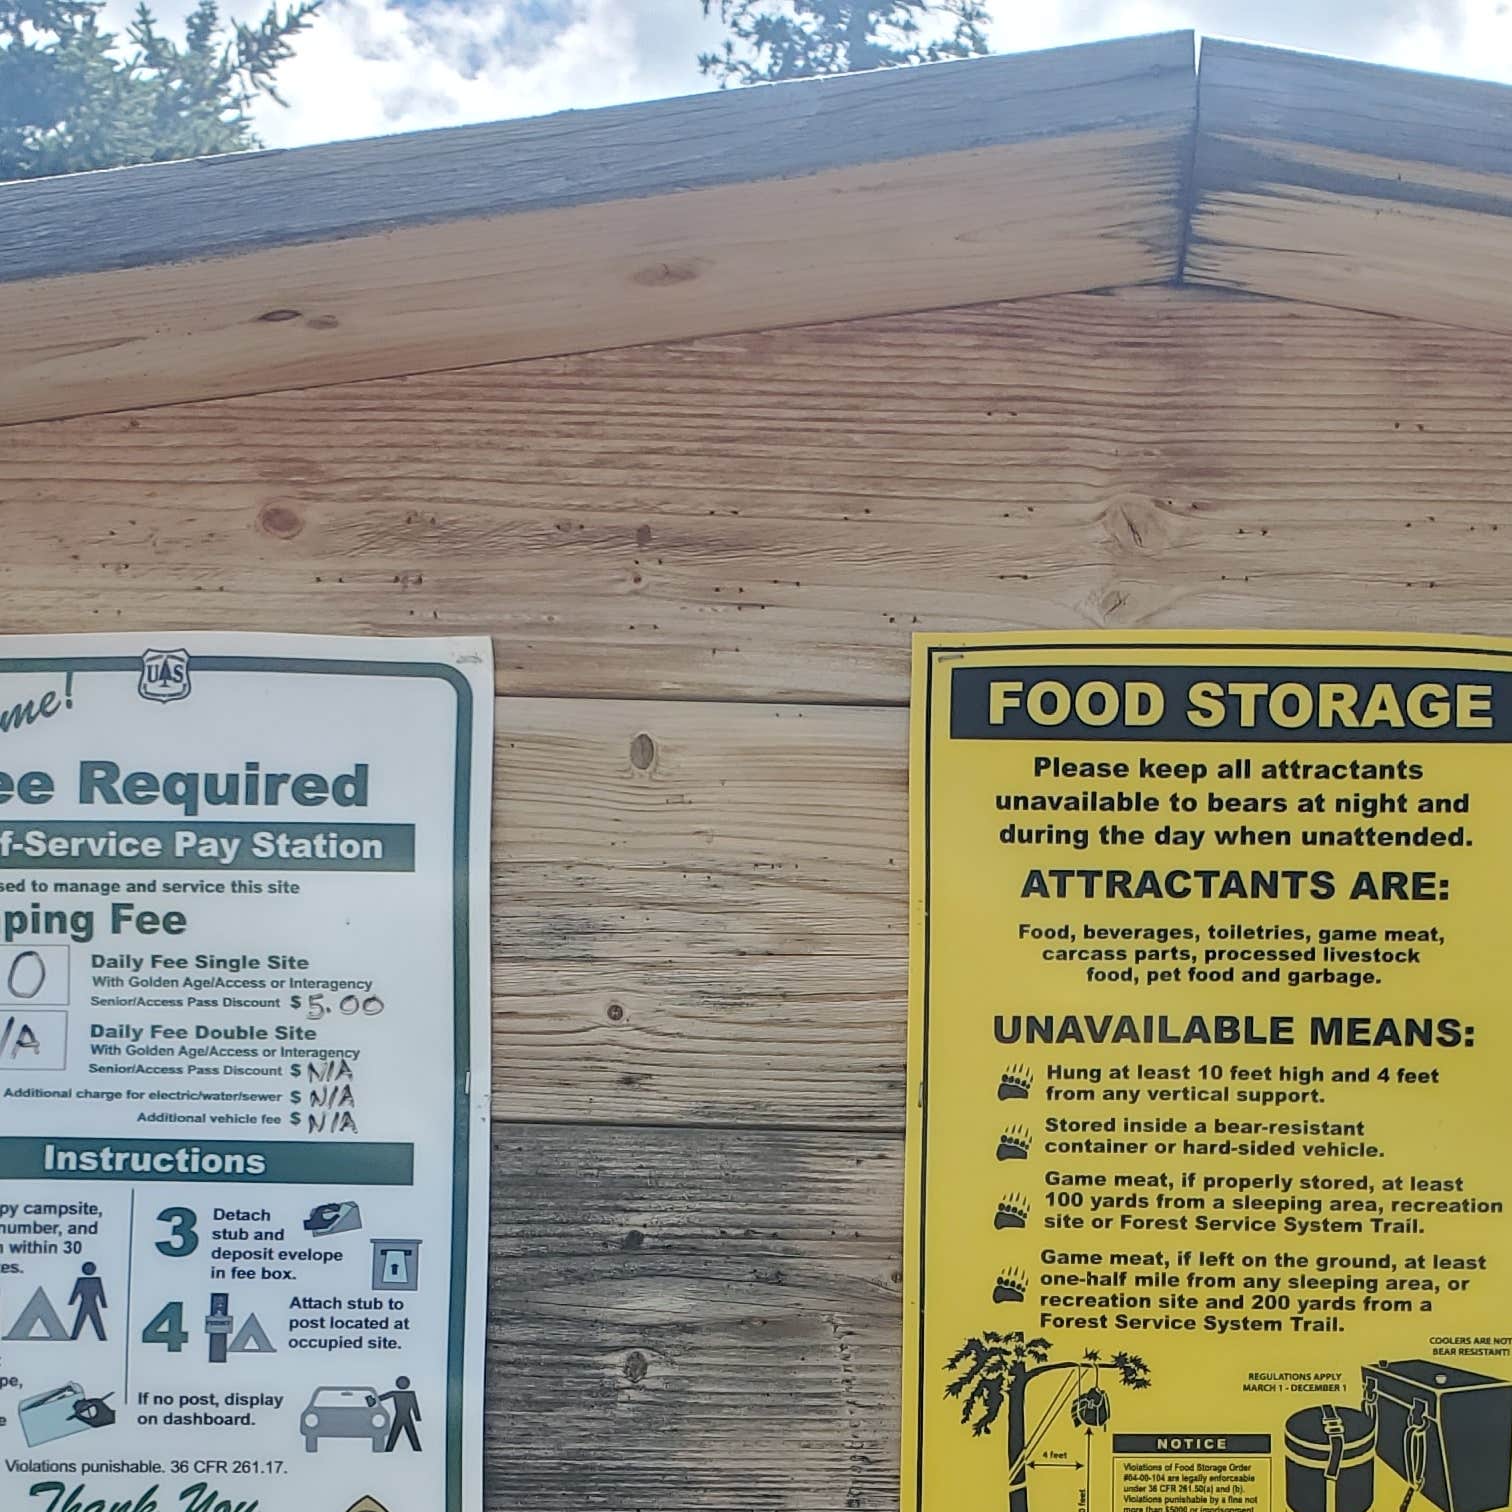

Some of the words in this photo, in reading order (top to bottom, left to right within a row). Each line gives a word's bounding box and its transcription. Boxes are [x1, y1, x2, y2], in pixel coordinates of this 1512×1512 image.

[987, 680, 1165, 728] FOOD
[1185, 682, 1494, 730] STORAGE
[1034, 756, 1130, 778] Please
[1139, 757, 1208, 784] keep
[1217, 758, 1251, 779] all
[1261, 759, 1424, 780] attractants
[79, 760, 369, 817] Required
[995, 791, 1160, 812] unavailable
[1169, 792, 1198, 813] to
[1207, 792, 1288, 813] bears
[1297, 793, 1326, 813] at
[1335, 792, 1408, 819] night
[1417, 793, 1469, 814] and
[999, 823, 1089, 850] during
[1098, 824, 1145, 845] the
[1154, 825, 1206, 851] day
[1214, 825, 1291, 846] when
[1301, 826, 1473, 847] unattended.
[175, 831, 241, 865] Pay
[251, 831, 383, 860] Station
[1020, 869, 1336, 900] ATTRACTANTS
[1349, 871, 1449, 901] ARE:
[111, 902, 187, 935] Fee
[1019, 923, 1076, 943] Food,
[1083, 924, 1200, 944] beverages,
[1207, 924, 1312, 943] toiletries,
[1318, 929, 1377, 945] game
[1384, 927, 1445, 946] meat,
[91, 954, 144, 973] Daily
[151, 954, 189, 969] Fee
[195, 954, 261, 973] Single
[267, 955, 310, 970] Site
[1042, 949, 1127, 961] carcass
[1134, 946, 1197, 965] parts,
[1204, 946, 1316, 965] processed
[1323, 946, 1420, 964] livestock
[1086, 966, 1139, 985] food,
[1147, 967, 1181, 986] pet
[1187, 966, 1234, 982] food
[1241, 967, 1280, 983] and
[1287, 967, 1382, 988] garbage.
[187, 996, 219, 1008] Pass
[222, 996, 281, 1008] Discount
[290, 995, 302, 1010] $
[994, 1015, 1294, 1045] UNAVAILABLE
[1310, 1016, 1475, 1048] MEANS:
[1045, 1117, 1116, 1133] Stored
[1123, 1117, 1188, 1133] inside
[1194, 1121, 1207, 1134] a
[1214, 1118, 1365, 1137] bear-resistant
[1044, 1138, 1148, 1154] container
[1154, 1142, 1177, 1154] or
[1183, 1139, 1295, 1156] hard-sided
[1302, 1141, 1385, 1158] vehicle.
[44, 1144, 266, 1176] Instructions
[213, 1207, 271, 1222] Detach
[154, 1206, 199, 1258] 3
[212, 1227, 249, 1241] stub
[253, 1228, 285, 1241] and
[211, 1246, 274, 1263] deposit
[278, 1248, 344, 1265] evelope
[210, 1266, 226, 1279] in
[231, 1266, 257, 1280] fee
[261, 1266, 297, 1280] box.
[289, 1296, 342, 1310] Attach
[347, 1297, 384, 1310] stub
[388, 1298, 404, 1311] to
[141, 1301, 189, 1353] 4
[289, 1317, 326, 1332] post
[330, 1316, 389, 1330] located
[393, 1317, 410, 1330] at
[288, 1335, 363, 1352] occupied
[367, 1336, 402, 1350] site.
[1429, 1336, 1472, 1345] COOLERS
[1474, 1336, 1492, 1345] ARE
[1493, 1337, 1512, 1345] NOT
[1432, 1347, 1457, 1356] BEAR
[1157, 1438, 1233, 1455] NOTICE
